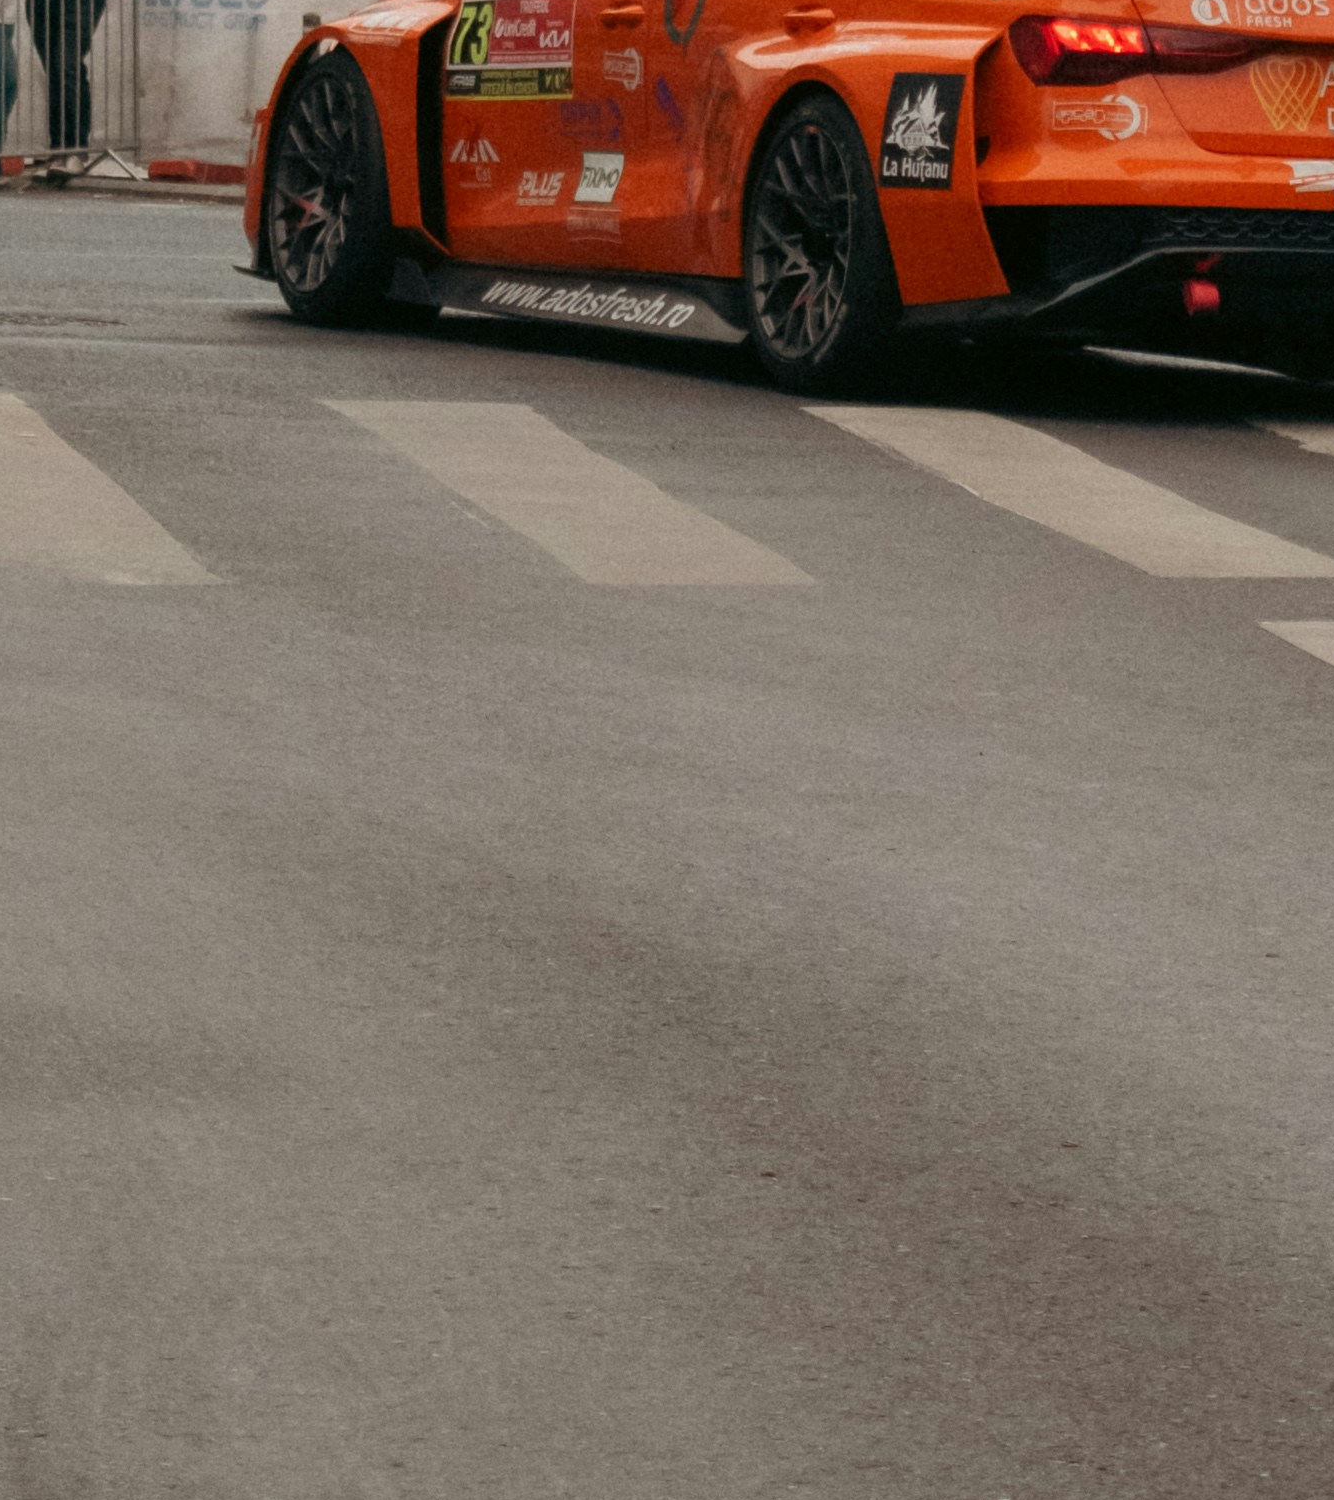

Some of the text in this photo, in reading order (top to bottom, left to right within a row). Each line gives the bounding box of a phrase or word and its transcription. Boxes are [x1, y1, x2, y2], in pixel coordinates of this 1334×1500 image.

[453, 3, 494, 65] 73
[1246, 15, 1293, 28] FRESH
[882, 156, 898, 177] La
[481, 281, 696, 328] www.adosfresh.ro
